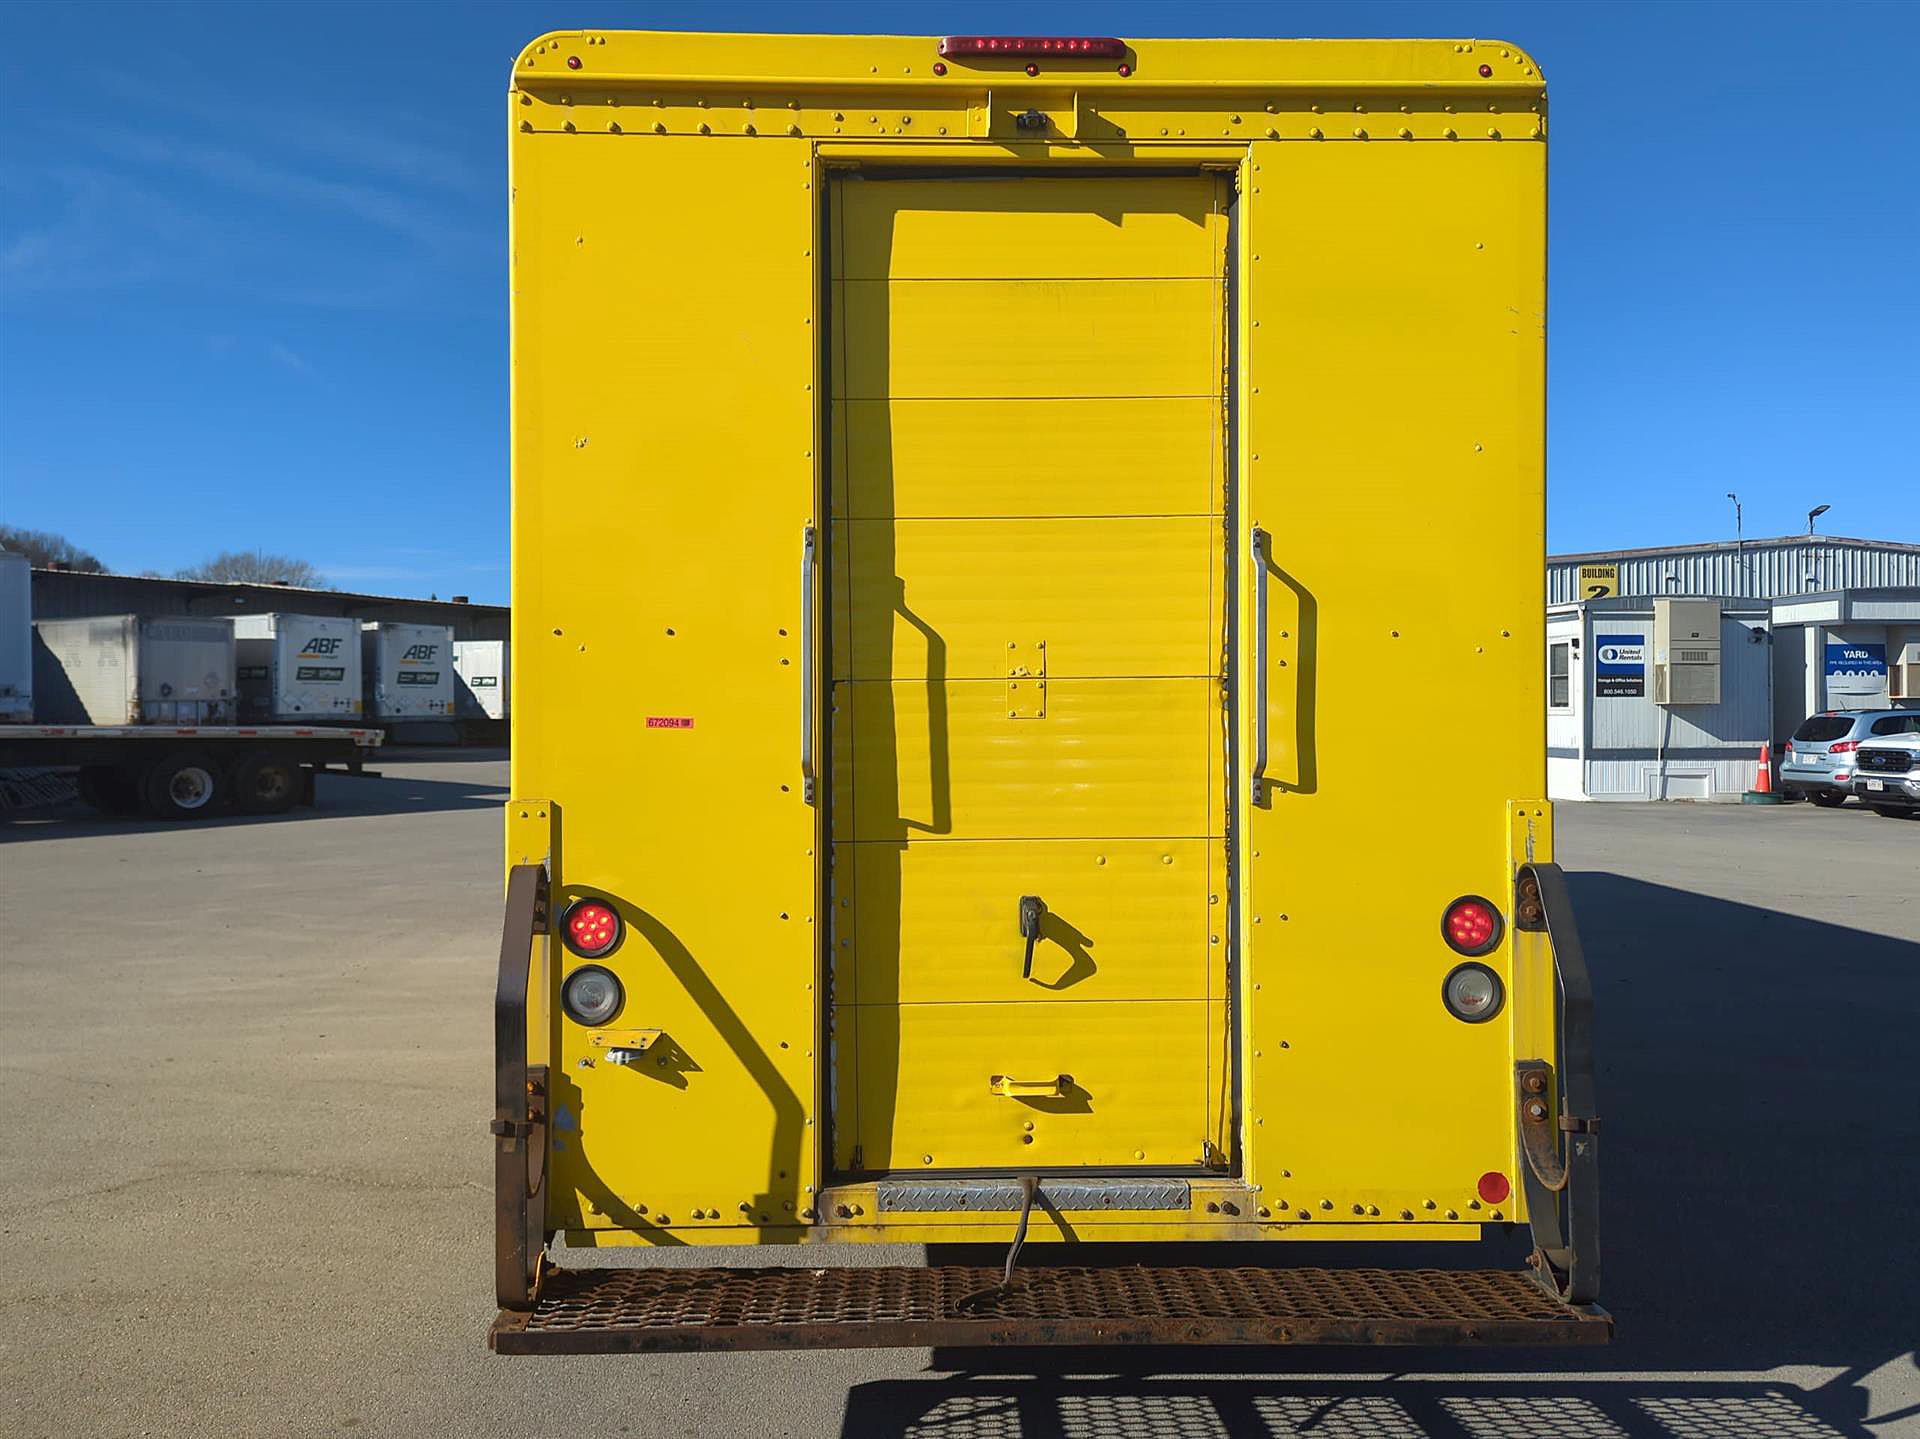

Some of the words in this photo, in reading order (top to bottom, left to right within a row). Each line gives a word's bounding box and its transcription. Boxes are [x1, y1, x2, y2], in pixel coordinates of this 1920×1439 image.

[1582, 568, 1615, 579] BUILDING
[1587, 585, 1610, 600] 2
[301, 637, 343, 654] ABF
[402, 644, 439, 660] ABF
[1843, 650, 1869, 659] YARD
[648, 718, 679, 727] 672094
